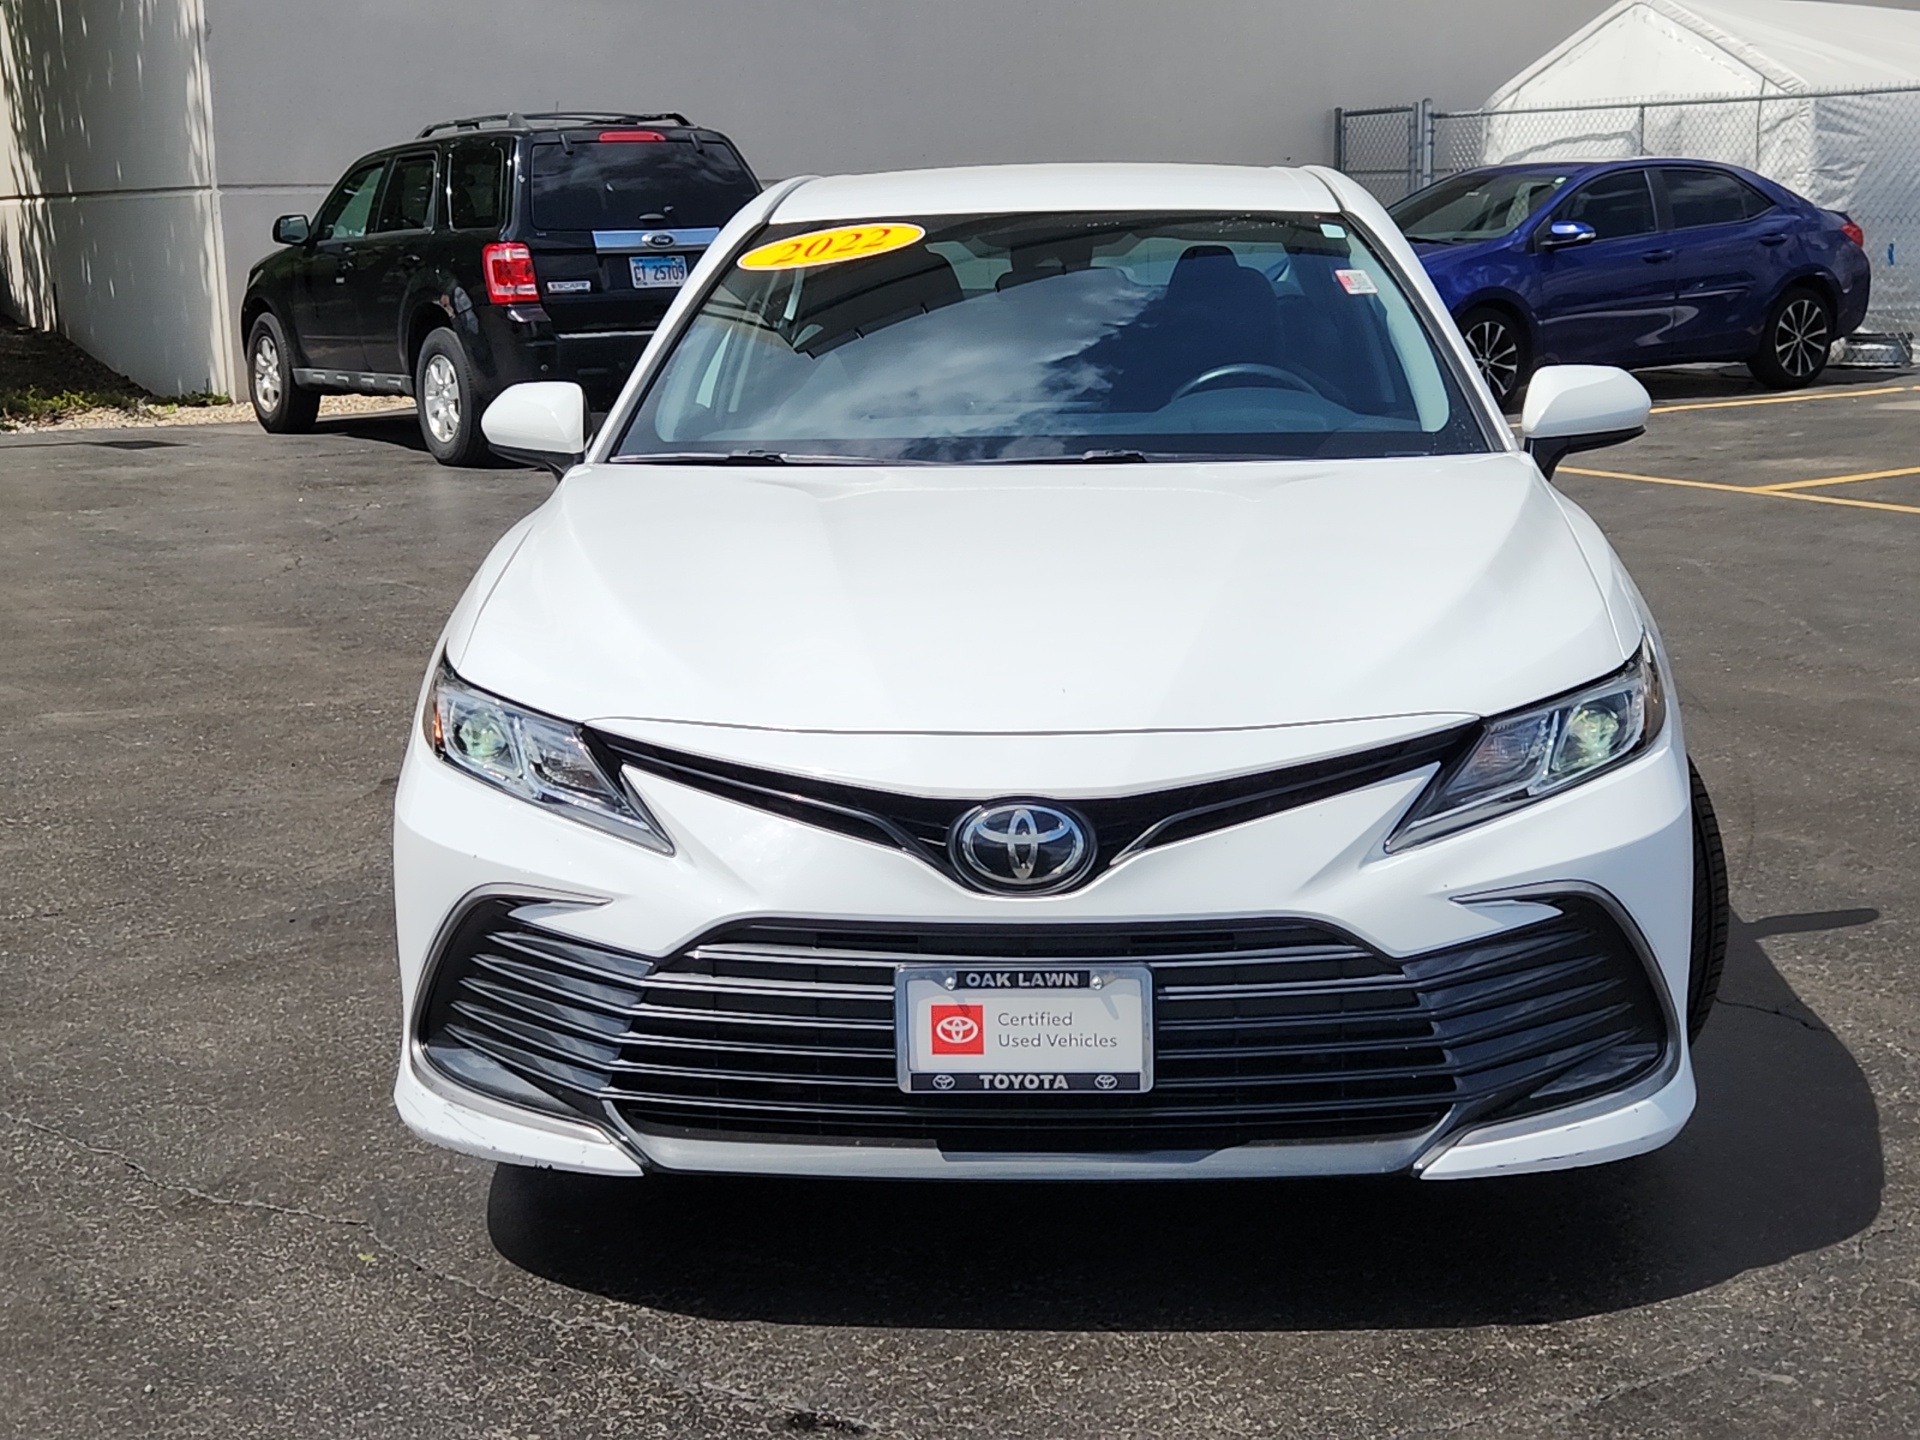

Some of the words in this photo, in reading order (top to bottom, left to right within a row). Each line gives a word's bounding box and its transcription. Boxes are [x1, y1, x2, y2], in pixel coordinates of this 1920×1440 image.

[771, 228, 891, 265] 2022
[966, 972, 1011, 987] OAK
[1018, 973, 1080, 987] LAWN
[997, 1012, 1073, 1026] Certified
[998, 1033, 1041, 1047] Used
[1046, 1033, 1118, 1047] Vehicles
[979, 1074, 1069, 1089] TOYOTA
